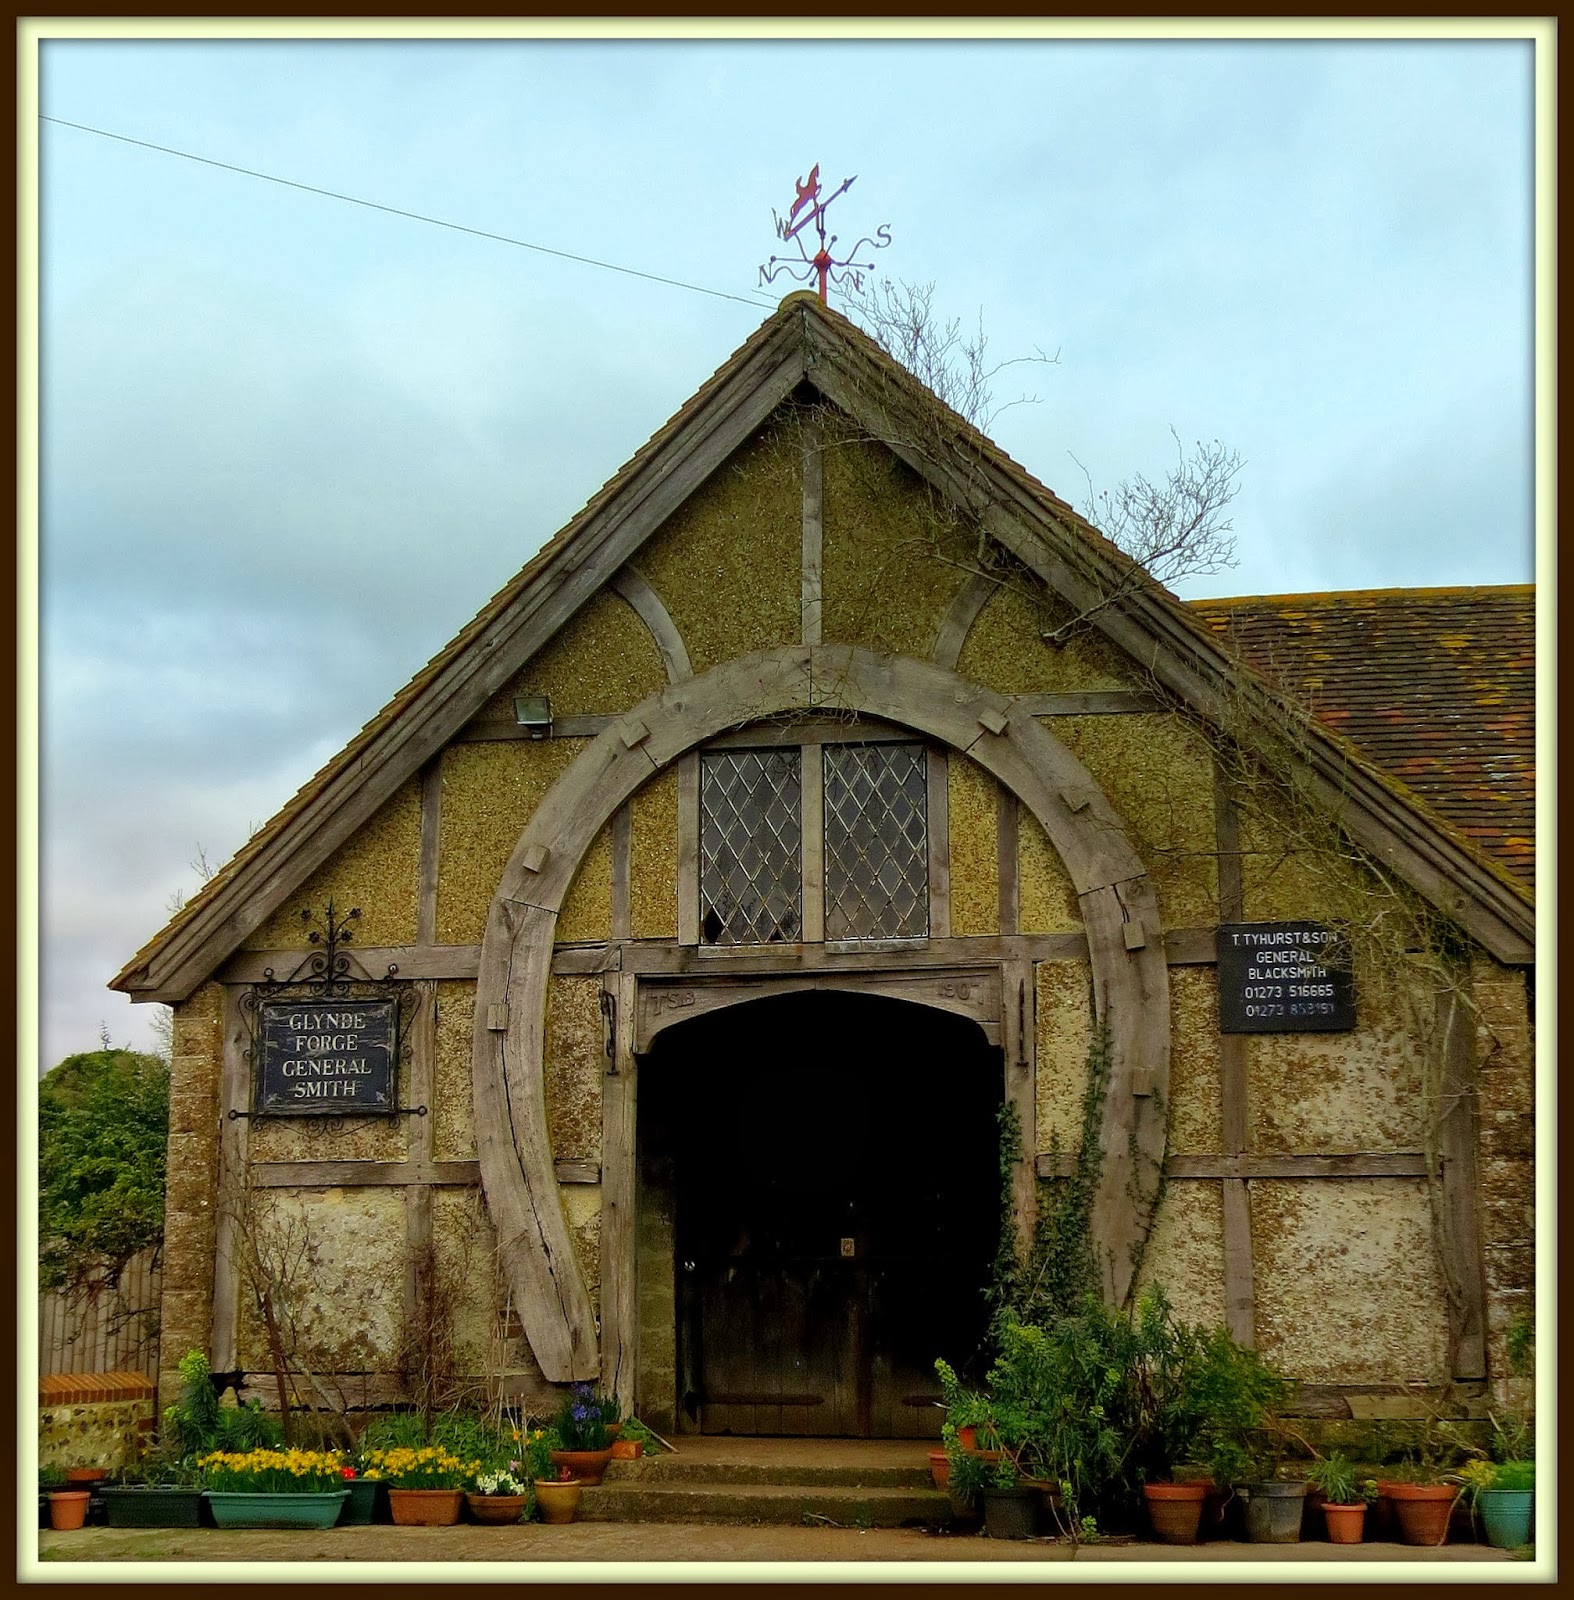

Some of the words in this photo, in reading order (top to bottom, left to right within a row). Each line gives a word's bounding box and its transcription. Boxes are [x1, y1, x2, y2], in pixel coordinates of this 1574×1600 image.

[771, 207, 793, 242] W
[875, 223, 892, 249] S
[758, 261, 773, 288] N
[855, 269, 866, 296] E
[1256, 950, 1314, 964] GENERAL
[1248, 966, 1327, 980] BLACKSMITH
[1244, 985, 1283, 999] 01273
[1289, 984, 1334, 998] 516665
[1245, 1003, 1285, 1017] 01273
[288, 1012, 367, 1031] GLYNDE
[295, 1034, 359, 1052] FORGE
[282, 1058, 372, 1077] GENERAL
[294, 1080, 357, 1099] SMITH
